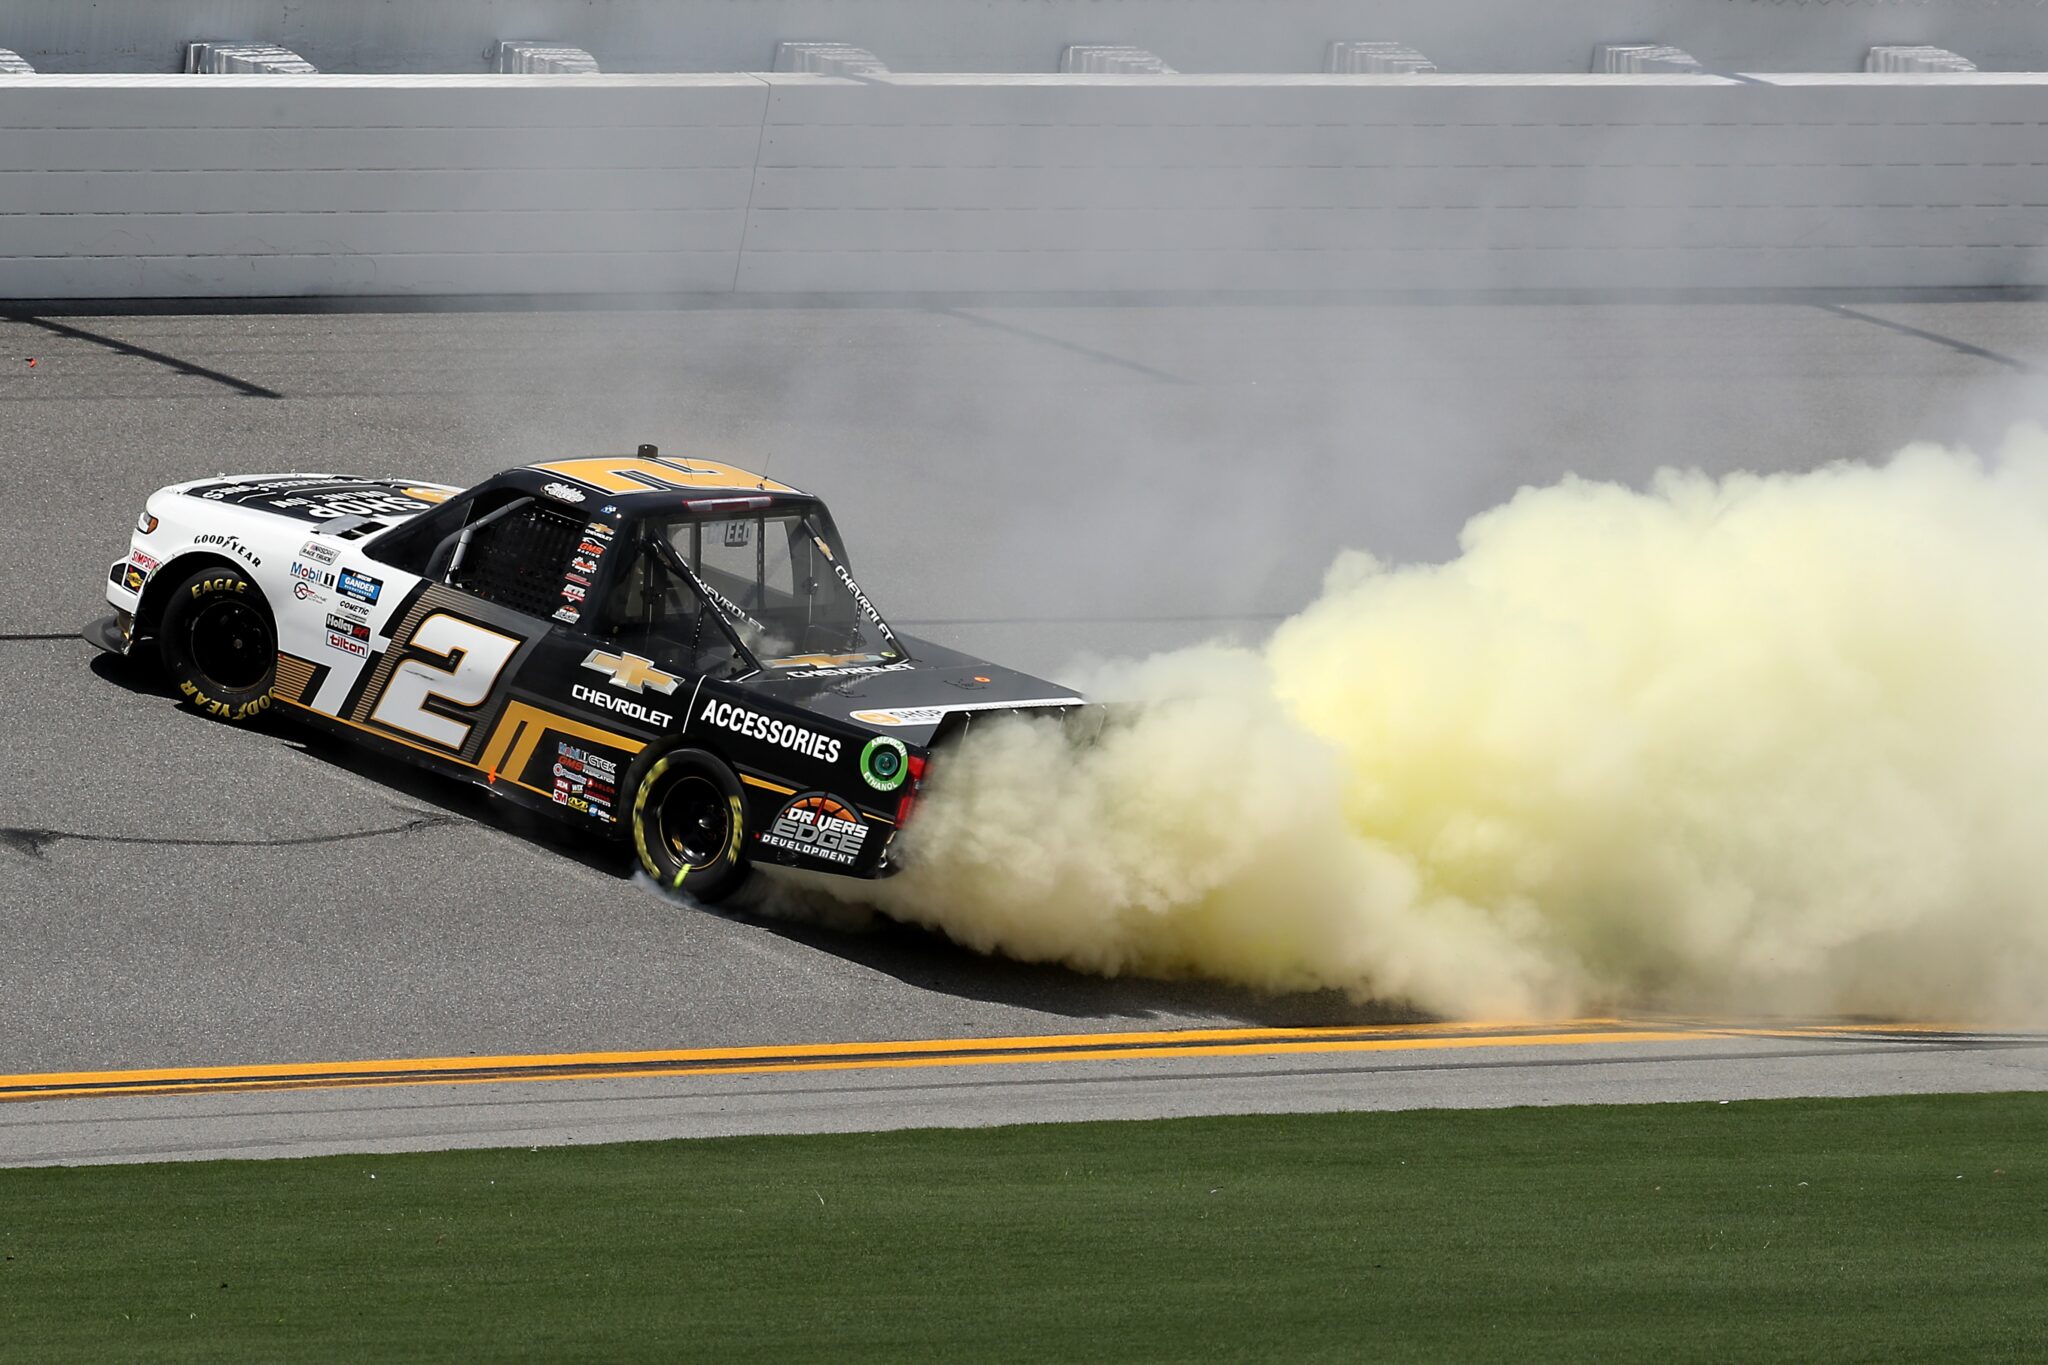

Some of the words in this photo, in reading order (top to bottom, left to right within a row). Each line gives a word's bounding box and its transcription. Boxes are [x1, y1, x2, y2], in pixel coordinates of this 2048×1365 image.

[308, 496, 430, 518] SHOP
[194, 535, 262, 568] GOODYEAR
[302, 548, 316, 557] RACE
[315, 552, 332, 563] TRUCK
[579, 542, 605, 554] GMS
[290, 561, 323, 583] Mobil
[191, 578, 248, 599] EAGLE
[344, 576, 375, 594] GANDER
[339, 600, 370, 616] COMETIC
[834, 564, 896, 642] CHEVROLET
[326, 614, 354, 635] Holley
[329, 634, 365, 656] tilton
[370, 613, 520, 749] 2
[786, 663, 915, 681] CHEVROLET
[571, 684, 673, 728] CHEVROLET
[700, 699, 842, 764] ACCESSORIES
[871, 736, 907, 757] AMERICAN
[559, 756, 583, 771] GMS
[588, 754, 617, 774] CTEK
[863, 771, 898, 791] ETHANOL
[554, 790, 568, 804] 3M
[786, 807, 870, 839] DRIVERS
[772, 817, 865, 856] EDGE
[761, 834, 855, 865] DEVELOPMENT
